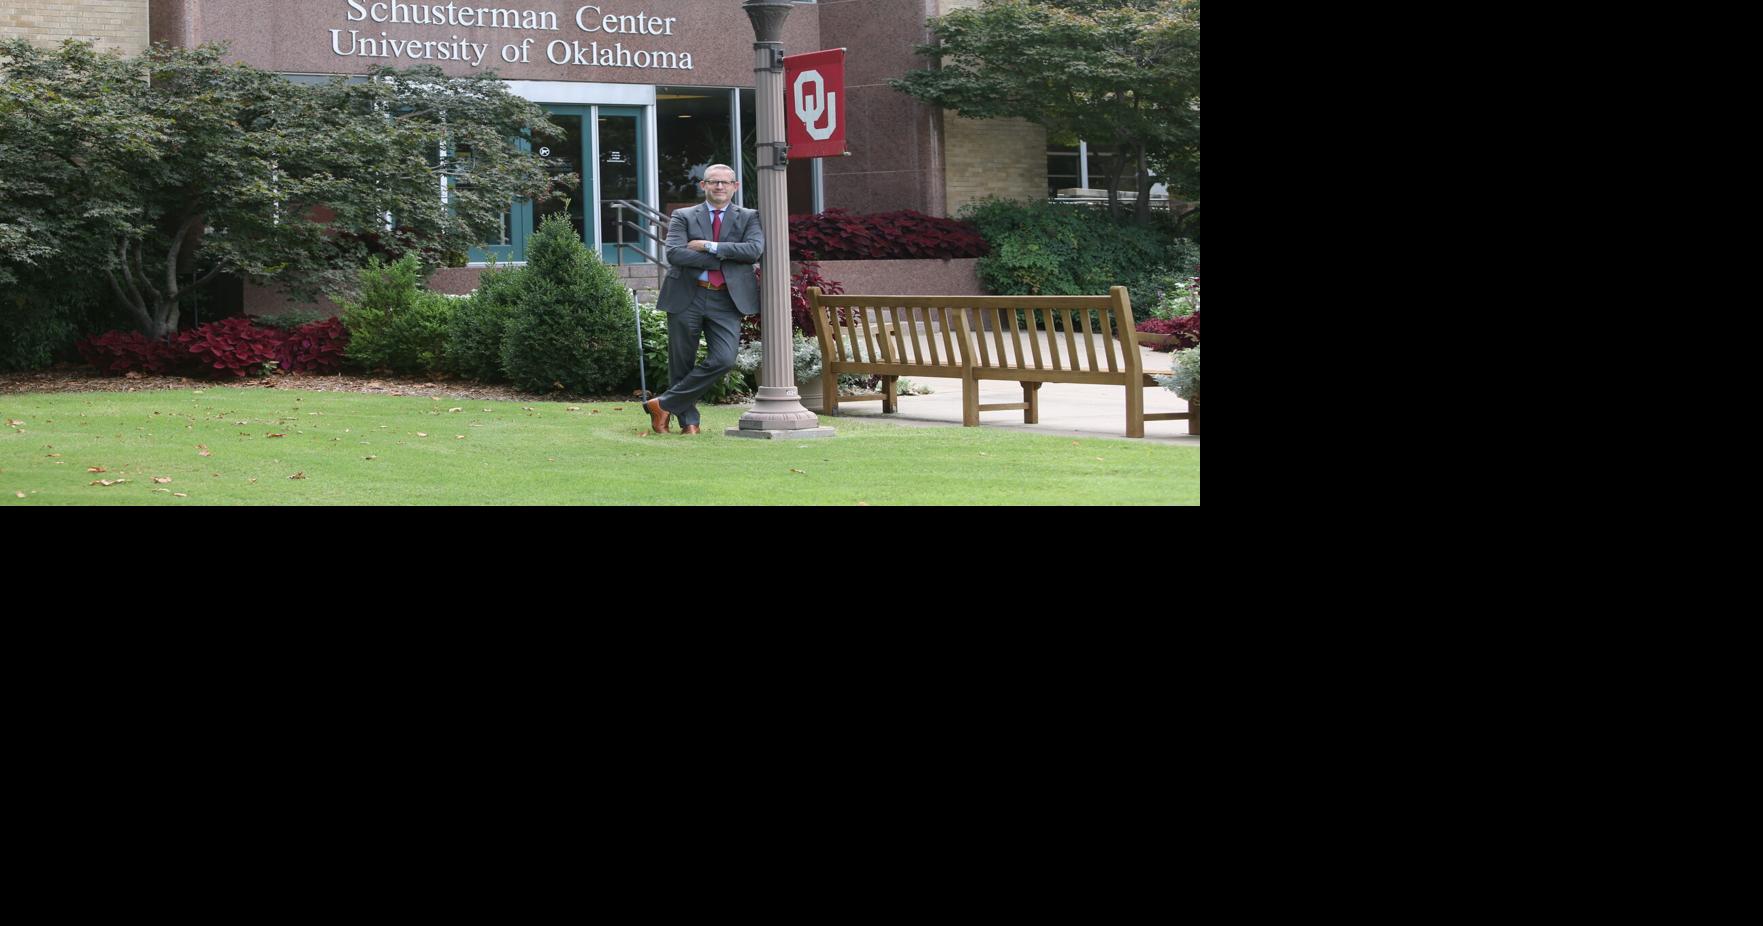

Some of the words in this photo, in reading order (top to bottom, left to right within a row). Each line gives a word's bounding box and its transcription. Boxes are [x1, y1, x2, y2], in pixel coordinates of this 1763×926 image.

[347, 0, 559, 31] Schusterman
[575, 5, 676, 35] Center
[329, 28, 488, 66] University
[501, 38, 534, 63] of
[546, 39, 694, 69] Oklahoma
[793, 69, 836, 140] OU
